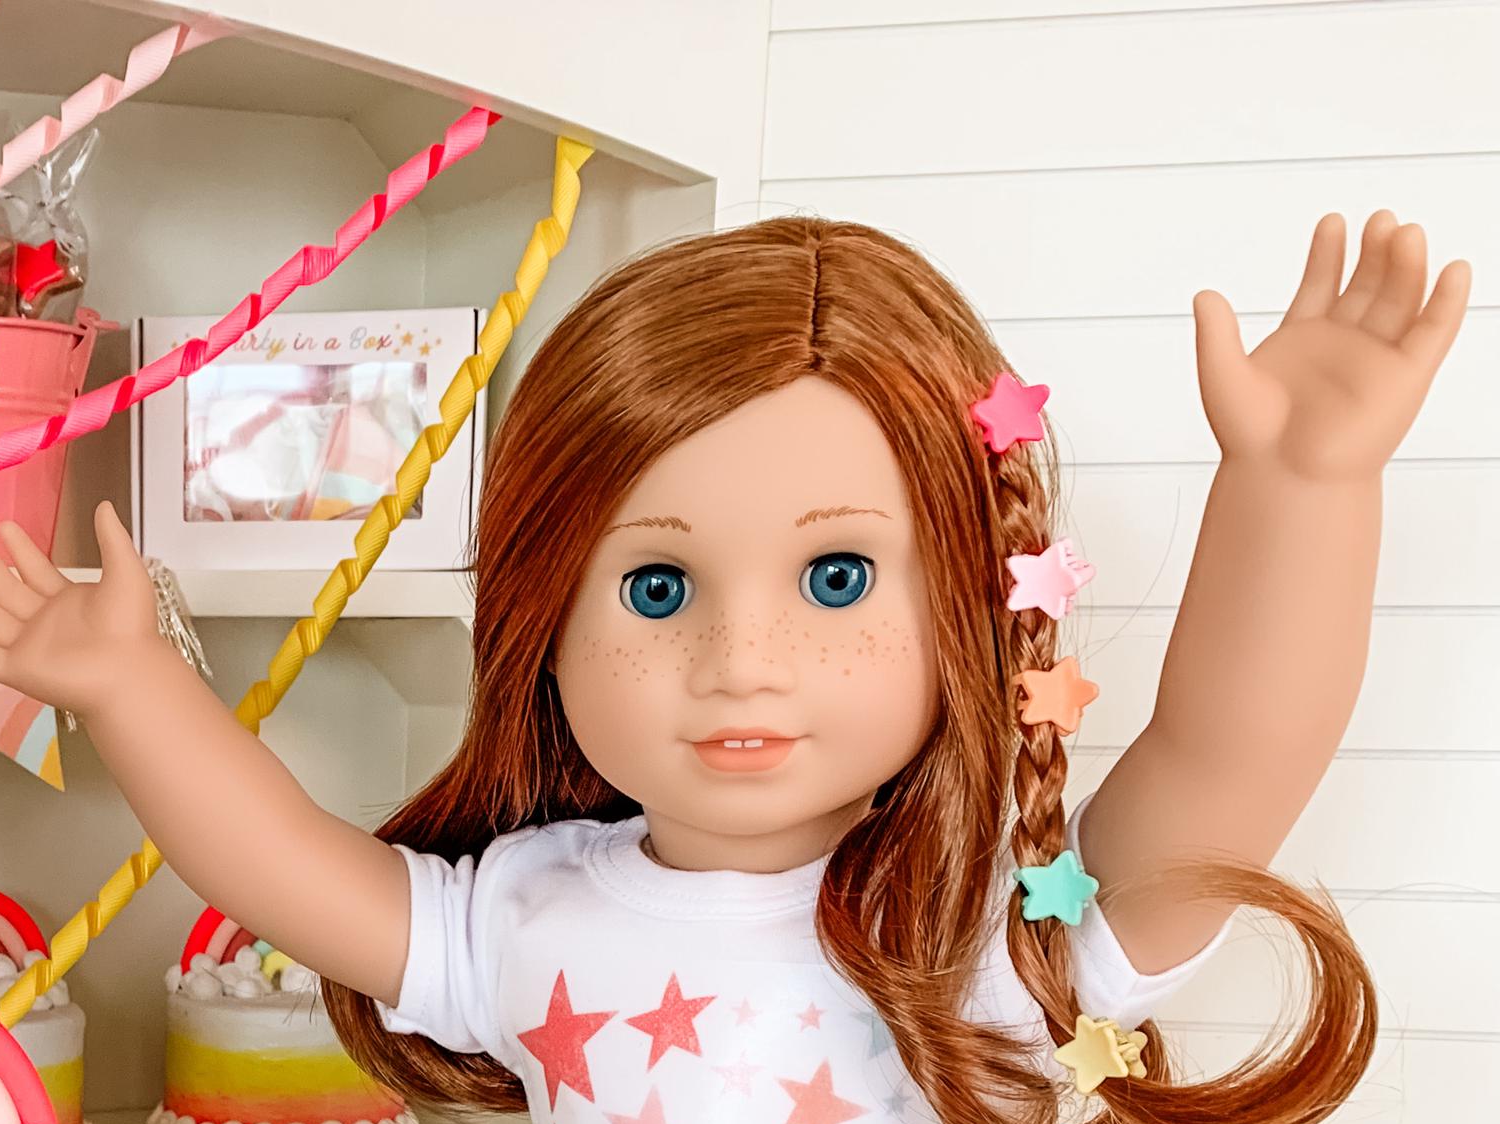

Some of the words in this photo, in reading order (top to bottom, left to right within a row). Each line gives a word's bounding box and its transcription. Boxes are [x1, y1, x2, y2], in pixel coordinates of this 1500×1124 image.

[233, 328, 287, 361] arty
[293, 332, 320, 351] in
[324, 337, 341, 351] a
[350, 326, 393, 351] Box
